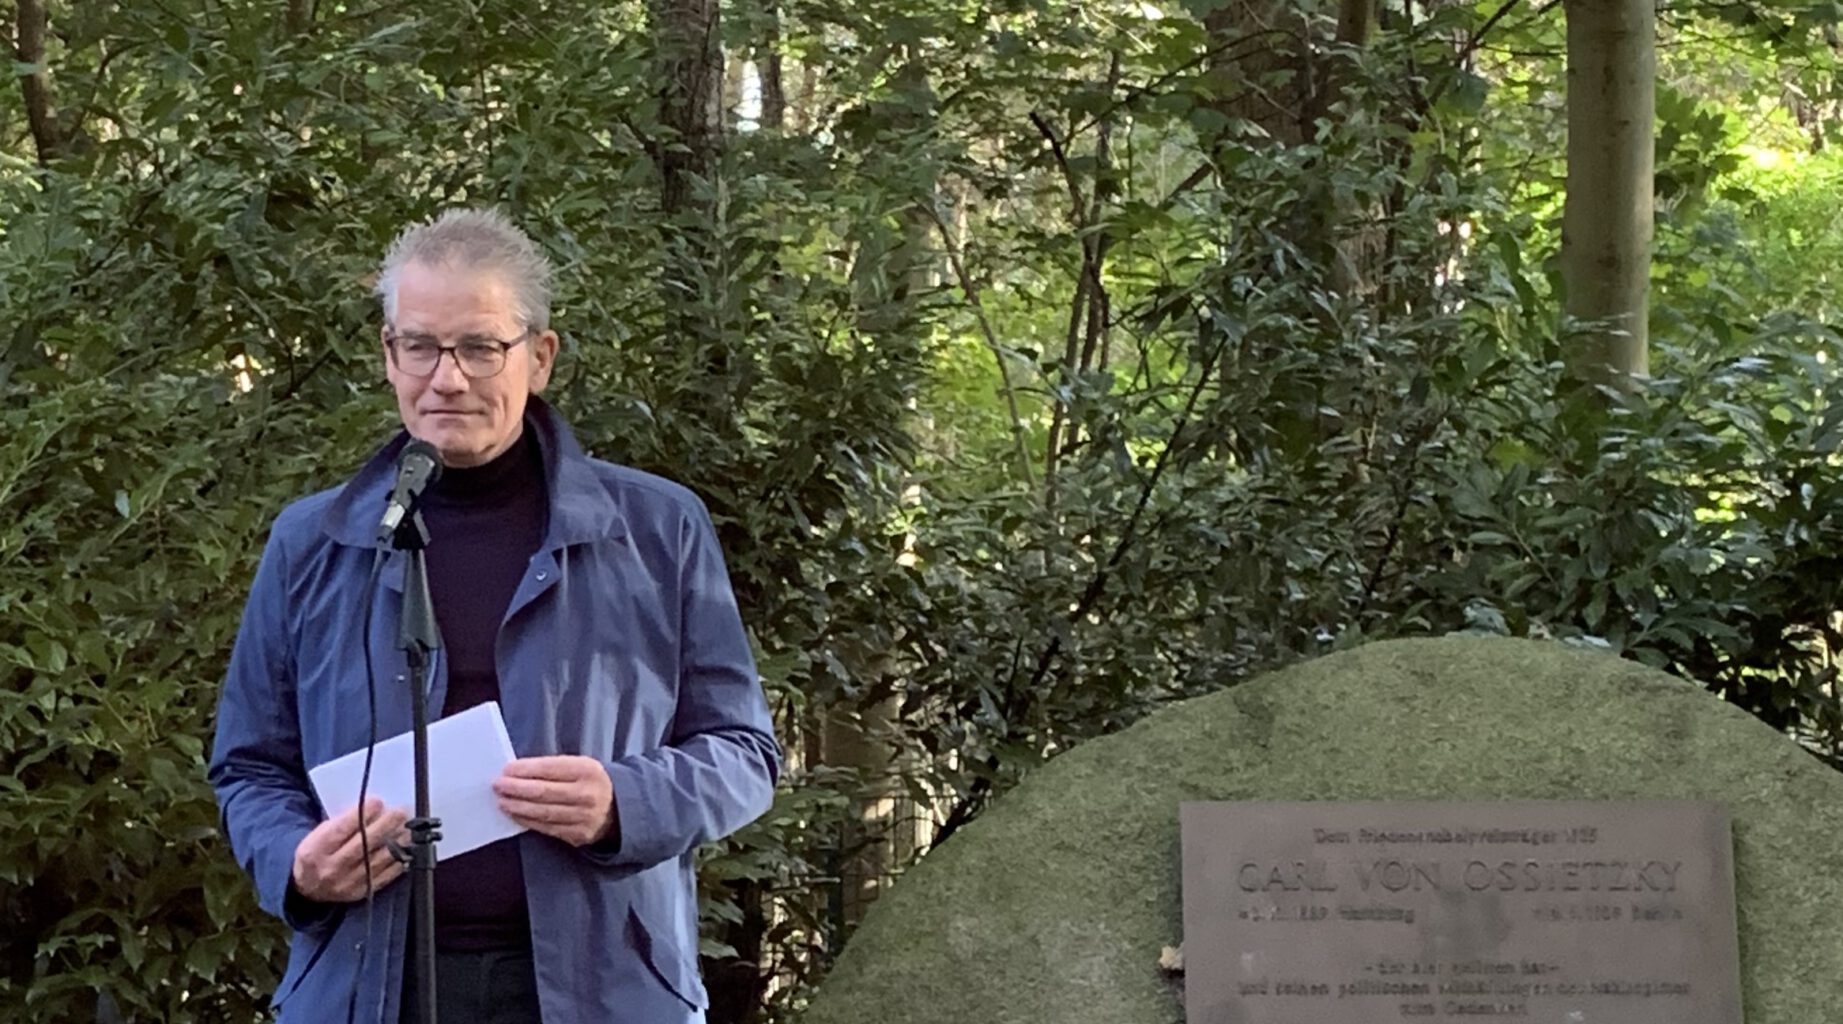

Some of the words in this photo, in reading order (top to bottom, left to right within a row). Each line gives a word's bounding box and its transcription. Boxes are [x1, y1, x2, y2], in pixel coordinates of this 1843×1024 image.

[1238, 862, 1338, 892] CARL
[1353, 860, 1442, 892] VON
[1464, 860, 1683, 892] OSSIETZKY
